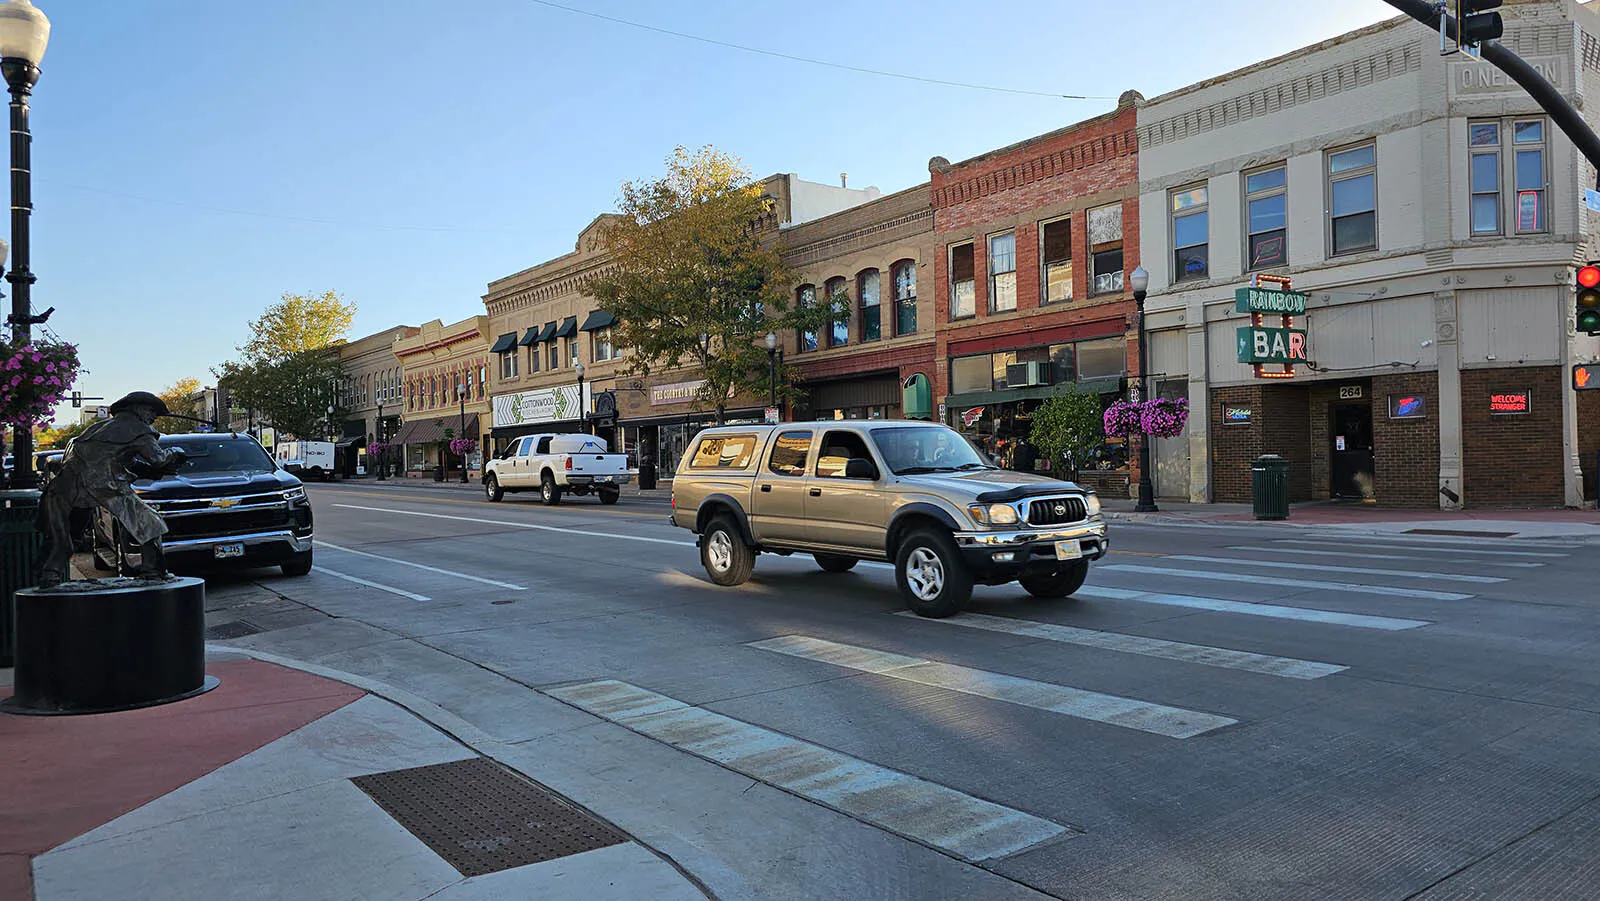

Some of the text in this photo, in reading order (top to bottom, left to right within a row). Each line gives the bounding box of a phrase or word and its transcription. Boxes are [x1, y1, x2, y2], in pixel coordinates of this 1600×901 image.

[1249, 290, 1307, 312] RAINBOW
[1254, 331, 1306, 359] BAR
[1341, 387, 1360, 397] 264
[522, 397, 554, 409] COTTONWOOD
[1491, 395, 1526, 403] WELCOME
